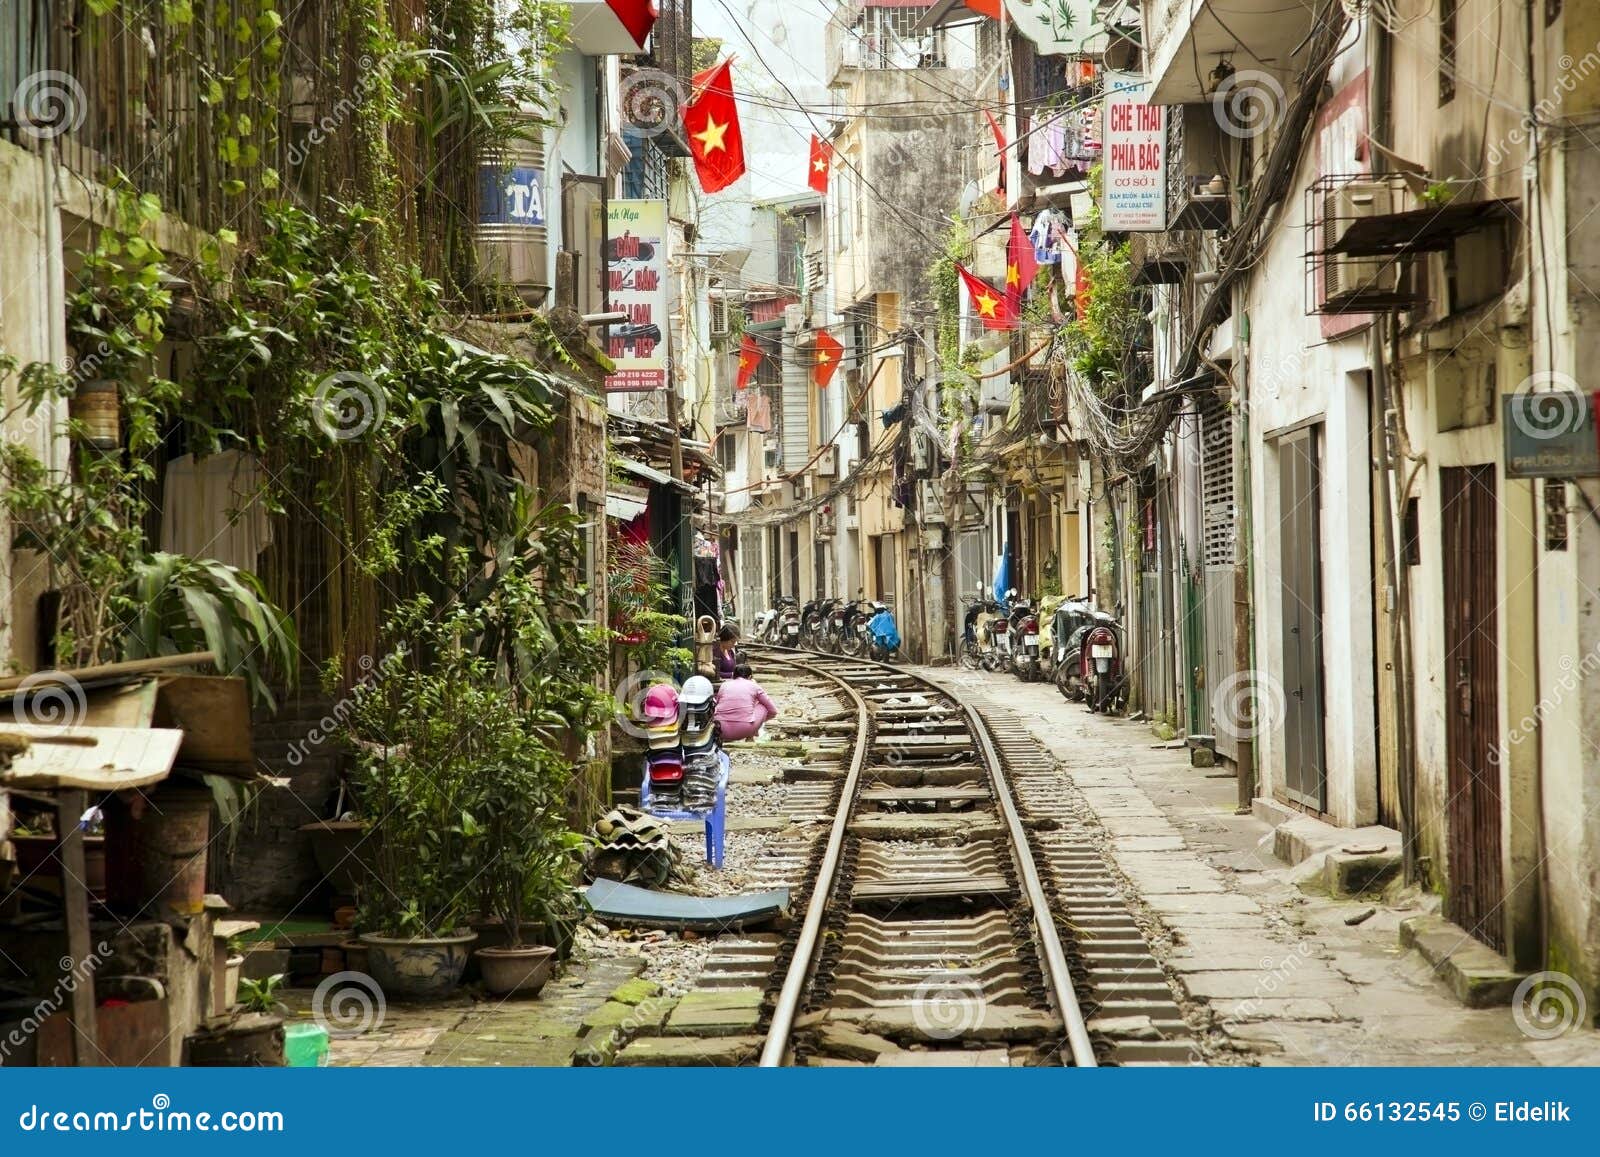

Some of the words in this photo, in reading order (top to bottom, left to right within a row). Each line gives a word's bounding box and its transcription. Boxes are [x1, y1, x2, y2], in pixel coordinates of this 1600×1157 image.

[1111, 137, 1136, 170] PHÍA
[1139, 133, 1160, 170] BẮC
[1114, 177, 1131, 187] CƠ
